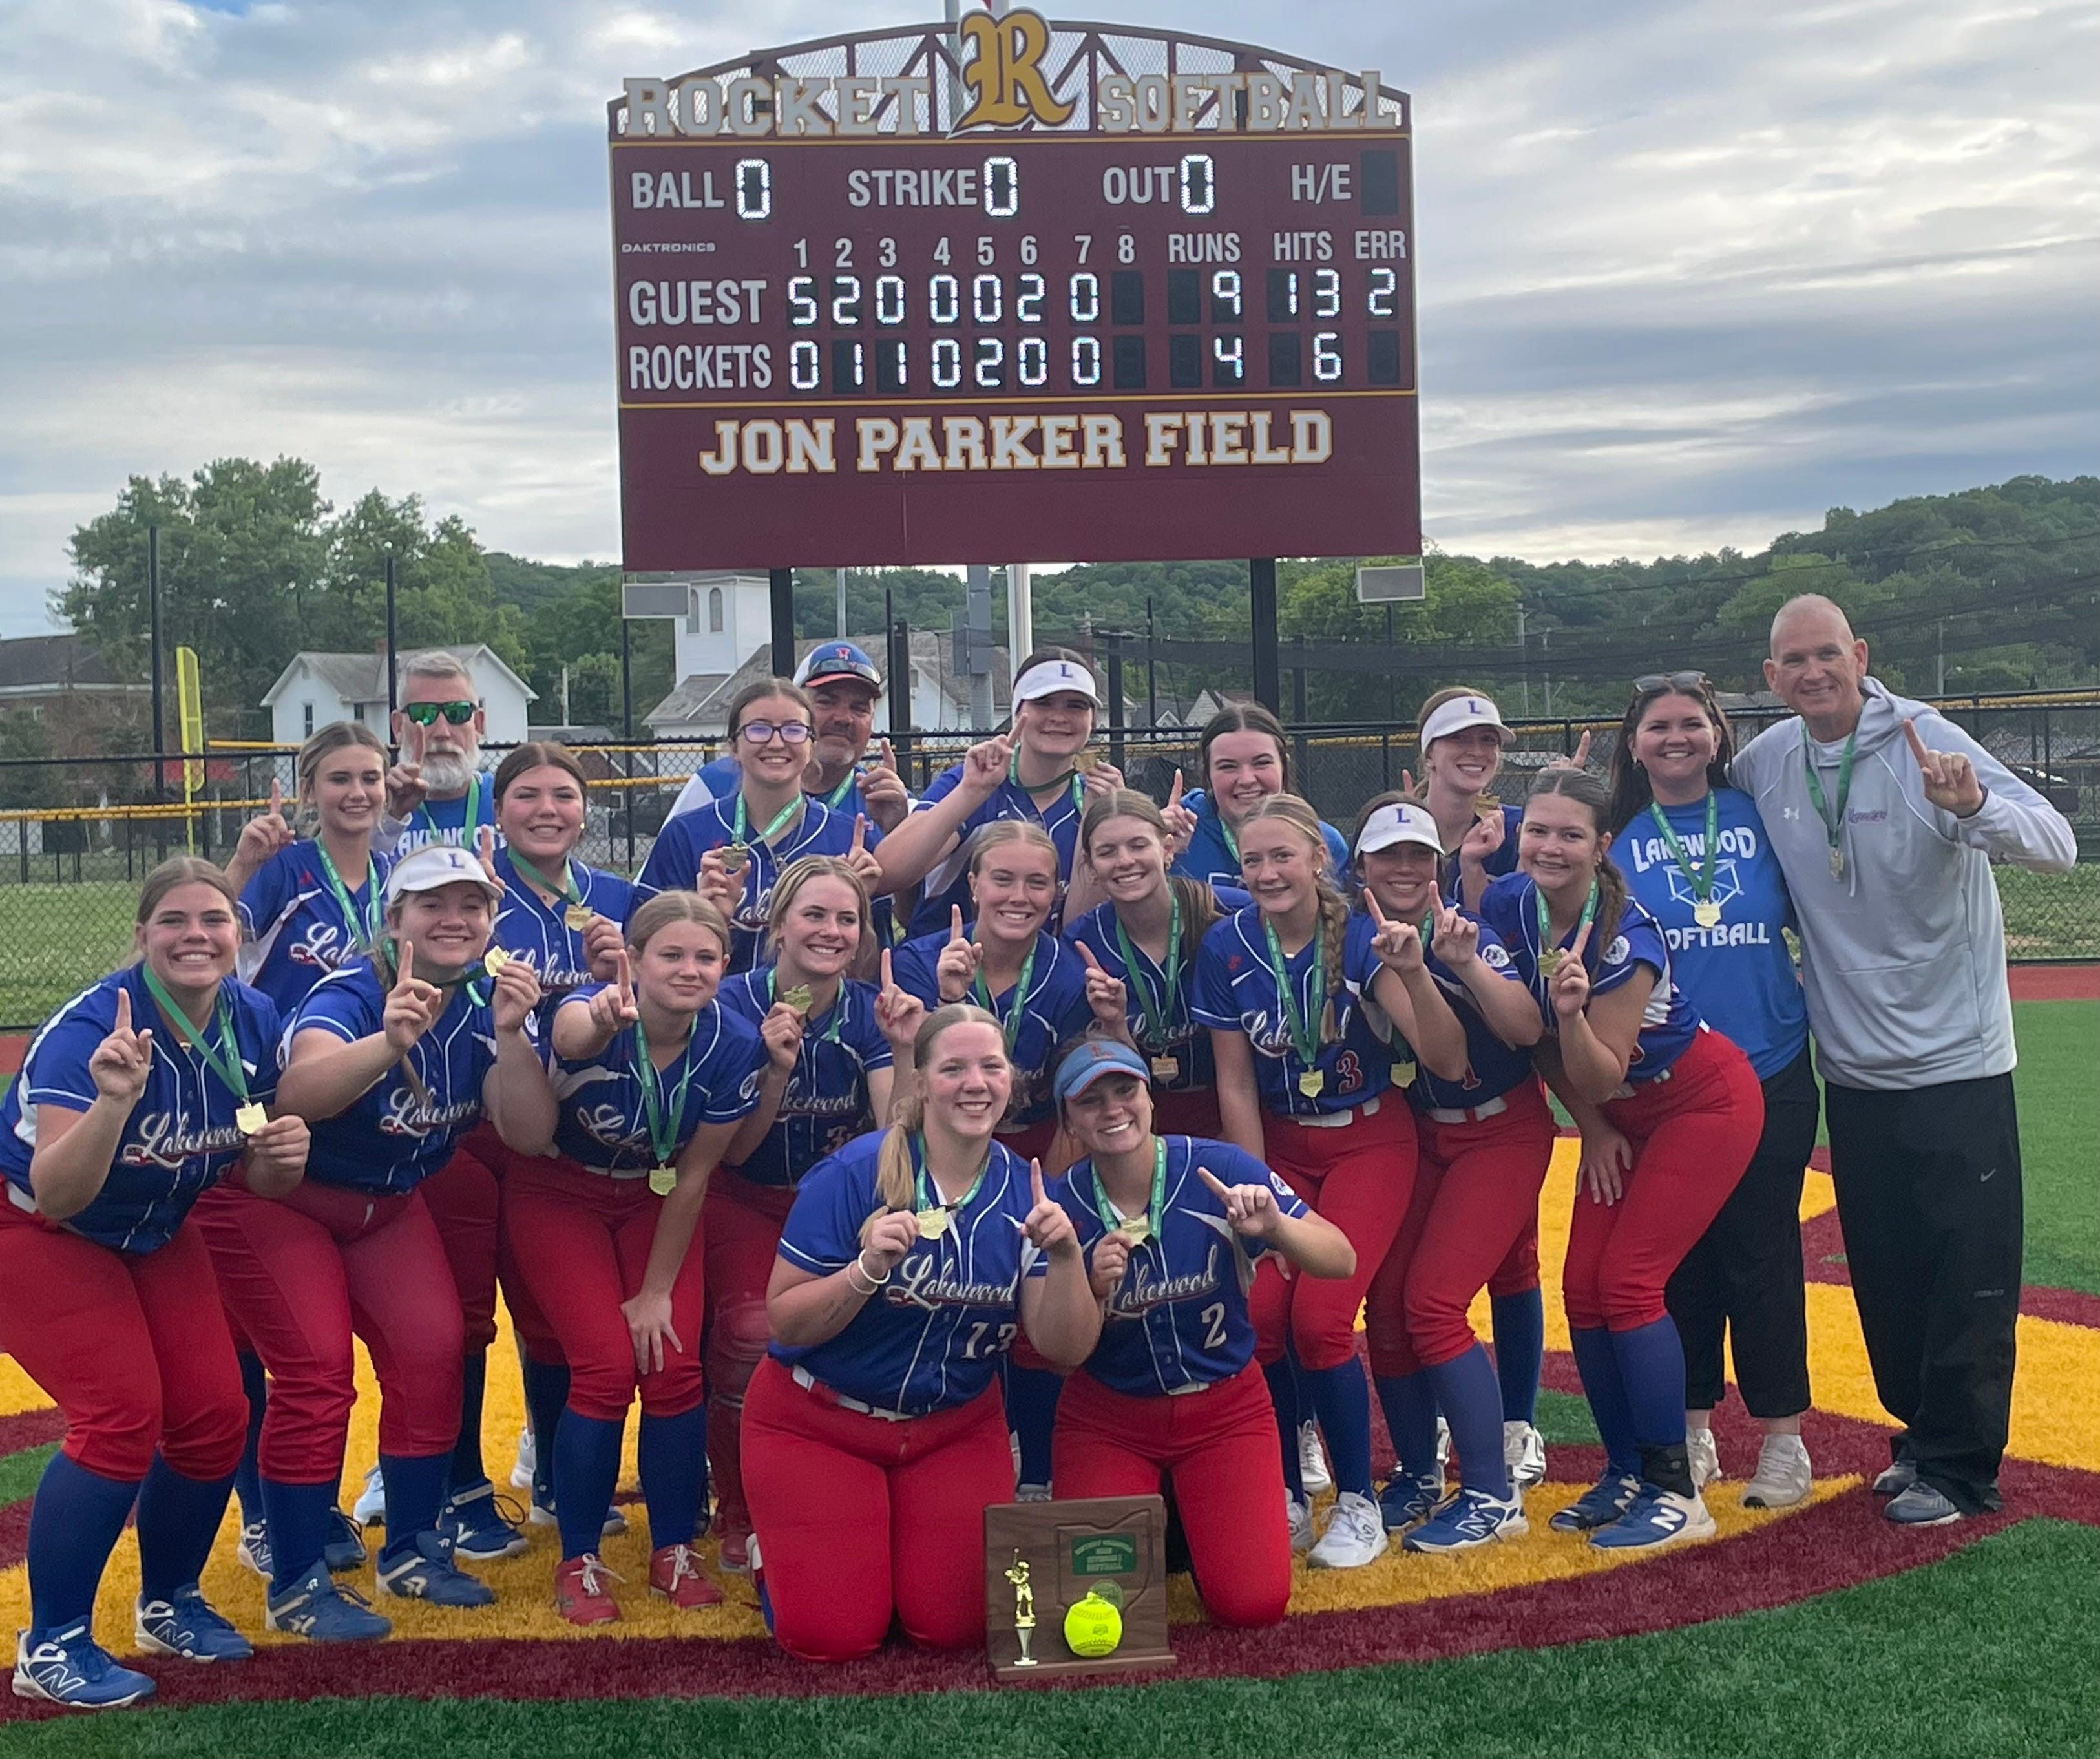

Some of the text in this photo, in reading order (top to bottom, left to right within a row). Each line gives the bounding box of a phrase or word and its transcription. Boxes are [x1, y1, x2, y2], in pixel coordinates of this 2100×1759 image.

[624, 70, 1396, 137] ROCKET SOFTBALL
[631, 154, 1352, 220] BALL 0 STRIKE 0 OUT 0 H/E
[622, 242, 716, 253] DAKTRONICS
[793, 229, 1406, 268] 1 2 3 4 5 6 7 8 RUNS HITS ERR
[629, 267, 1396, 326] GUEST 5 2 0 0 0 2 0 9 13 2
[629, 332, 1342, 390] ROCKETS 0 1 1 0 2 0 0 4 6
[699, 409, 1332, 476] JON PARKER FIELD
[1060, 663, 1074, 679] L
[1467, 700, 1482, 715] L
[1396, 807, 1411, 823] L
[448, 853, 465, 869] L
[1665, 922, 1770, 951] OFTBALL
[1336, 1049, 1363, 1095] 3
[885, 1254, 1019, 1311] Lakewood
[1201, 1301, 1227, 1350] 2
